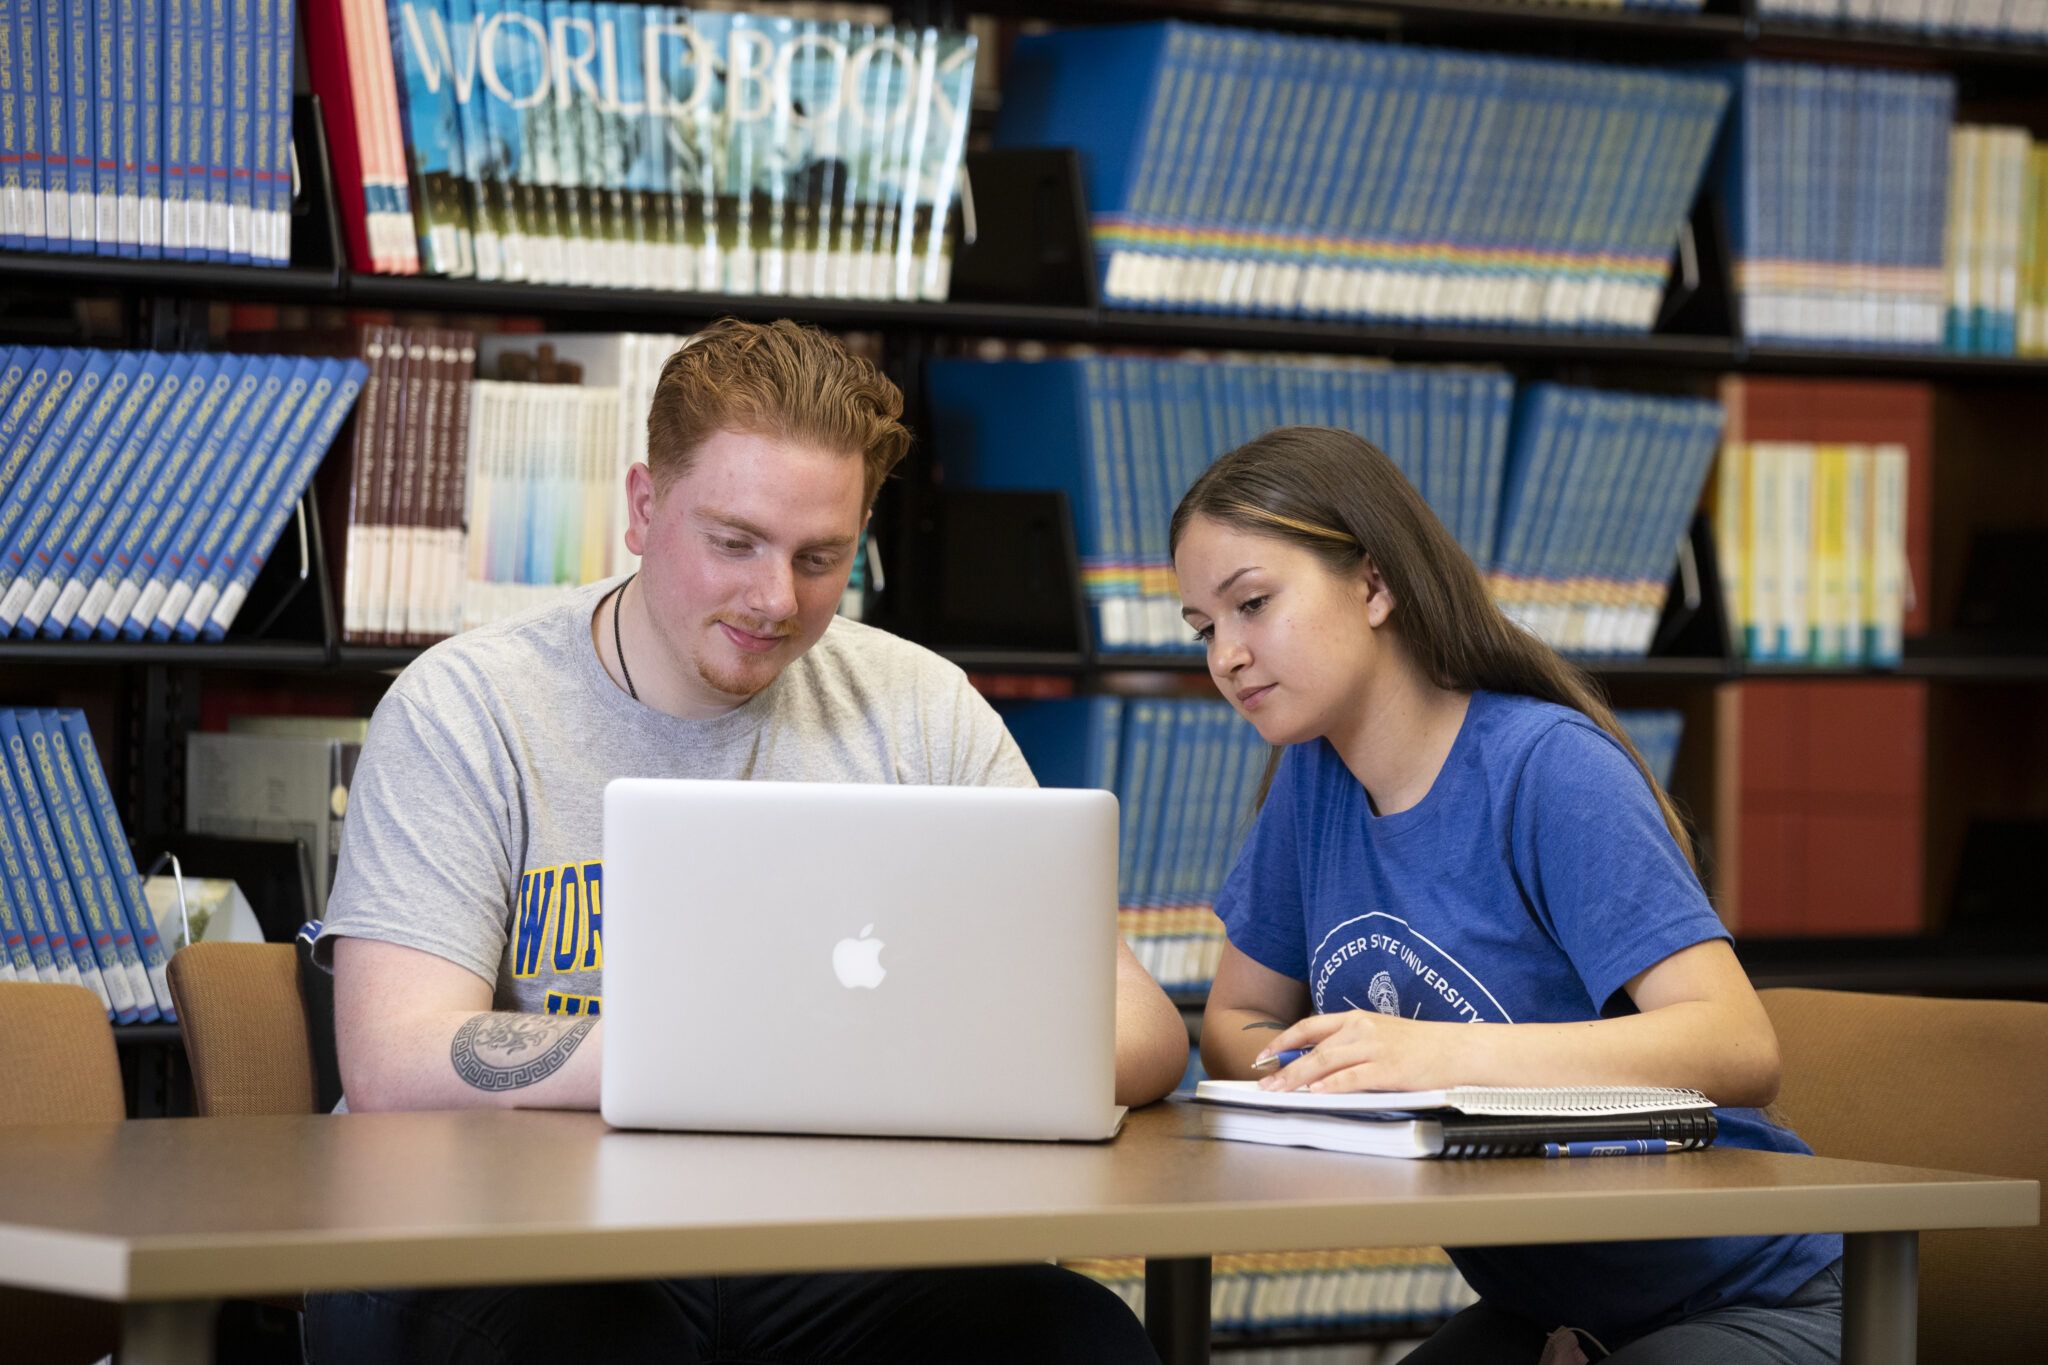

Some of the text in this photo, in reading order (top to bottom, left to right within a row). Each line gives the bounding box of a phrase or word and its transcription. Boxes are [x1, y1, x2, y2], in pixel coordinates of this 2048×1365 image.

[404, 3, 977, 129] WORLD BOOK
[18, 436, 61, 501] Literature
[47, 437, 90, 503] Literature
[18, 502, 52, 552] Review
[12, 806, 40, 878] Literature
[37, 878, 59, 933] Review
[14, 878, 37, 932] Review
[33, 808, 62, 881] Literature
[57, 881, 81, 934] Review
[56, 803, 85, 877] Literature
[81, 876, 104, 931] Review
[76, 803, 104, 876] Literature
[101, 876, 124, 930] Review
[128, 876, 149, 930] Review
[1314, 937, 1367, 1014] ORCESTER
[1401, 946, 1484, 1024] UNIVERSITY
